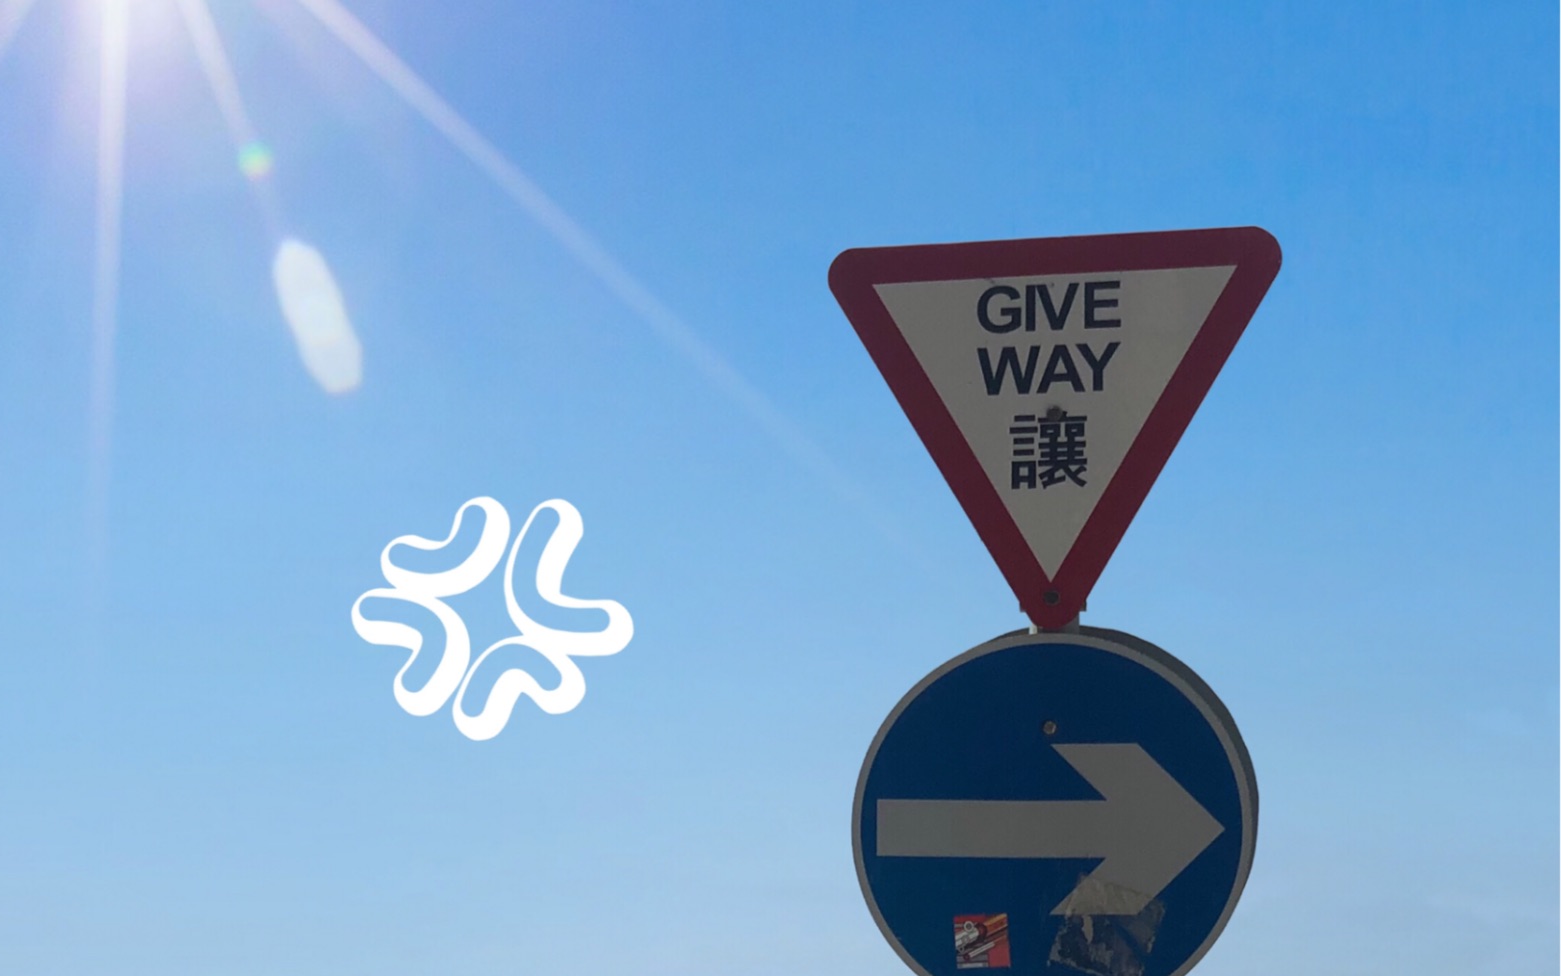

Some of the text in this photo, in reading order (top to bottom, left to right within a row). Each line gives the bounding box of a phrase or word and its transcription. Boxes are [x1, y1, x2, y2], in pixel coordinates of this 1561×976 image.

[976, 280, 1122, 334] GIVE
[977, 342, 1121, 396] WAY
[1009, 406, 1088, 490] 讓
